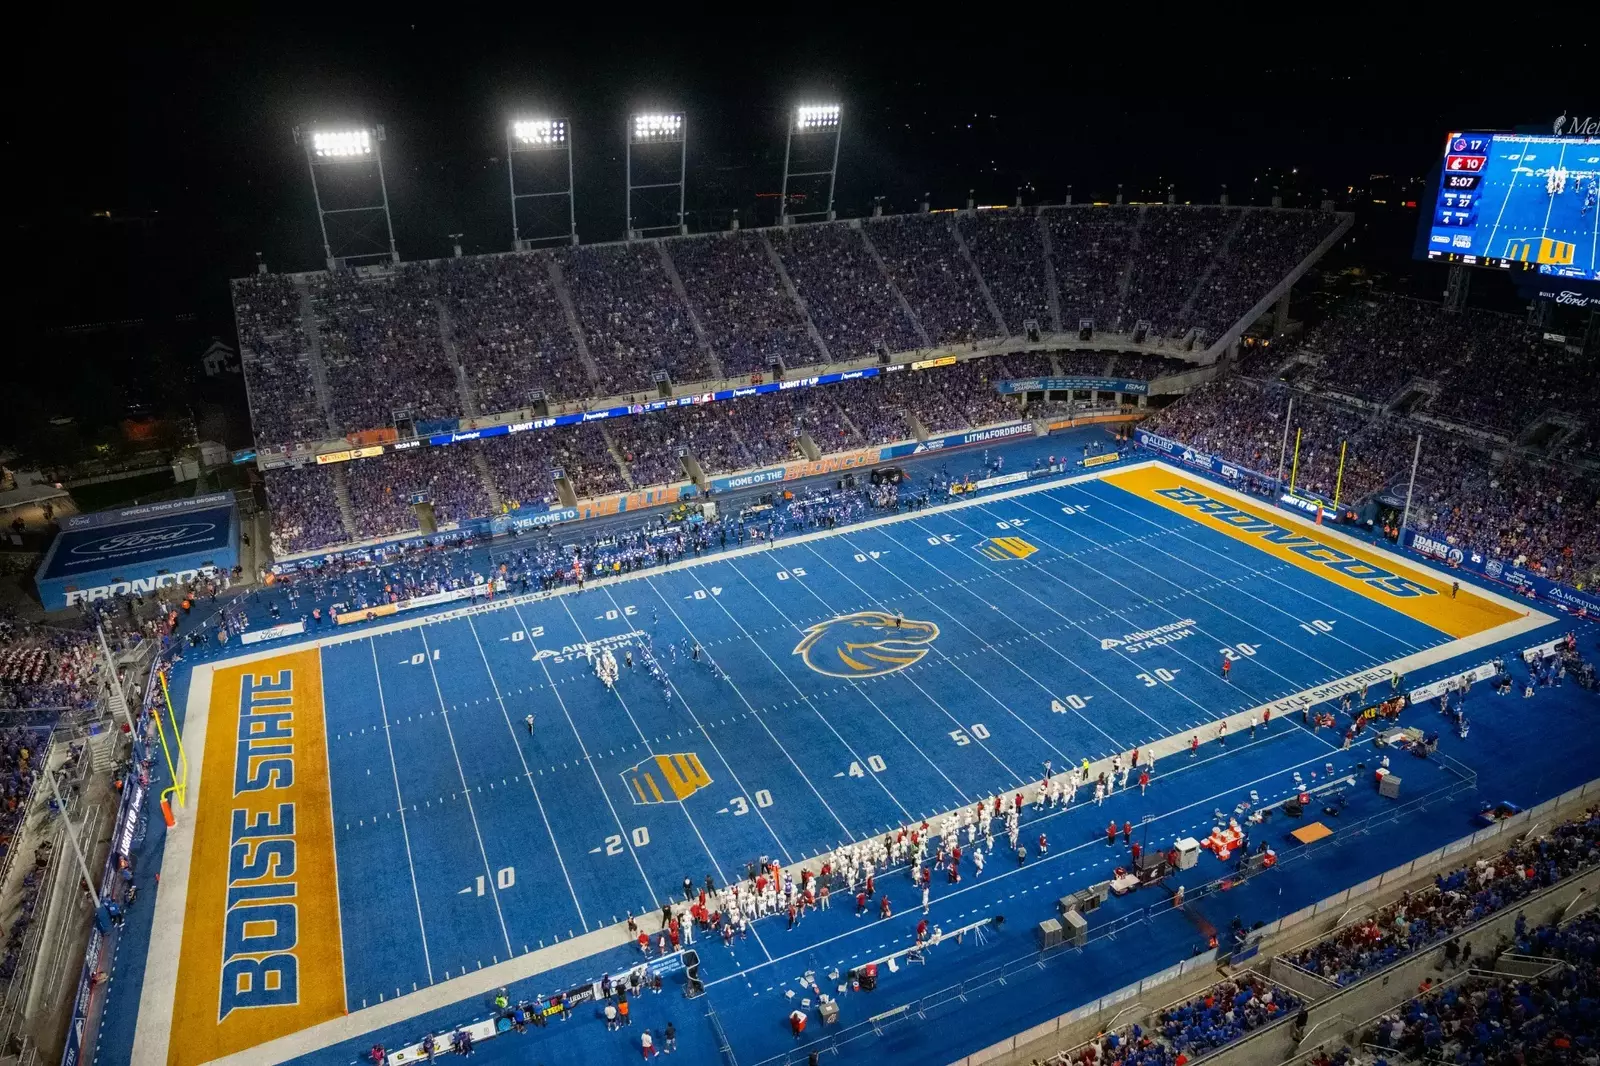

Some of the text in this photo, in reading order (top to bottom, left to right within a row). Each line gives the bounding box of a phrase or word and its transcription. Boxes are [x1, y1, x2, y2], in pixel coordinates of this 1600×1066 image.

[1471, 140, 1481, 150] 17
[1467, 160, 1478, 169] 10
[1450, 178, 1473, 187] 3:07
[1458, 199, 1470, 207] 27
[1556, 290, 1589, 307] Ford
[779, 380, 801, 390] LIGHT
[809, 377, 819, 385] UP
[508, 418, 557, 433] LIGHT IT UP
[1149, 436, 1174, 451] ALLIED
[784, 450, 881, 481] BRONCOS
[728, 470, 783, 488] HOME OF THE
[121, 508, 150, 517] OFFICIAL
[152, 503, 173, 512] TRUCK
[197, 494, 226, 504] BRONCOS
[1062, 504, 1087, 515] 10
[69, 516, 90, 526] Ford
[513, 510, 575, 529] WELCOME TO
[996, 518, 1025, 530] 20
[99, 527, 190, 551] Ford
[927, 534, 956, 546] 30
[1151, 485, 1440, 598] BRONCOS
[1413, 534, 1449, 553] IDAHO
[854, 550, 880, 563] 40
[776, 567, 806, 581] 50
[693, 586, 723, 600] 40
[424, 611, 460, 623] LYLE
[466, 600, 509, 614] SMITH
[513, 591, 553, 604] FIELD
[606, 605, 638, 621] 30
[259, 628, 286, 640] Ford
[511, 626, 545, 642] 20
[1122, 617, 1197, 645] Albertsons
[1299, 619, 1334, 636] 10
[560, 628, 646, 653] Albertsons
[1124, 628, 1194, 654] STADIUM
[411, 649, 441, 665] 10
[553, 639, 634, 664] STADIUM
[1219, 643, 1257, 661] 20
[1135, 668, 1174, 688] 30
[1274, 667, 1394, 713] LYLE SMITH FIELD
[1050, 694, 1086, 714] 40
[232, 669, 295, 799] STATE
[948, 723, 992, 746] 50
[848, 755, 888, 778] 40
[729, 789, 774, 816] 30
[121, 829, 133, 856] LIGHT
[128, 809, 136, 823] UP
[603, 826, 651, 857] 20
[475, 867, 516, 897] 10
[218, 803, 300, 1026] BOISE
